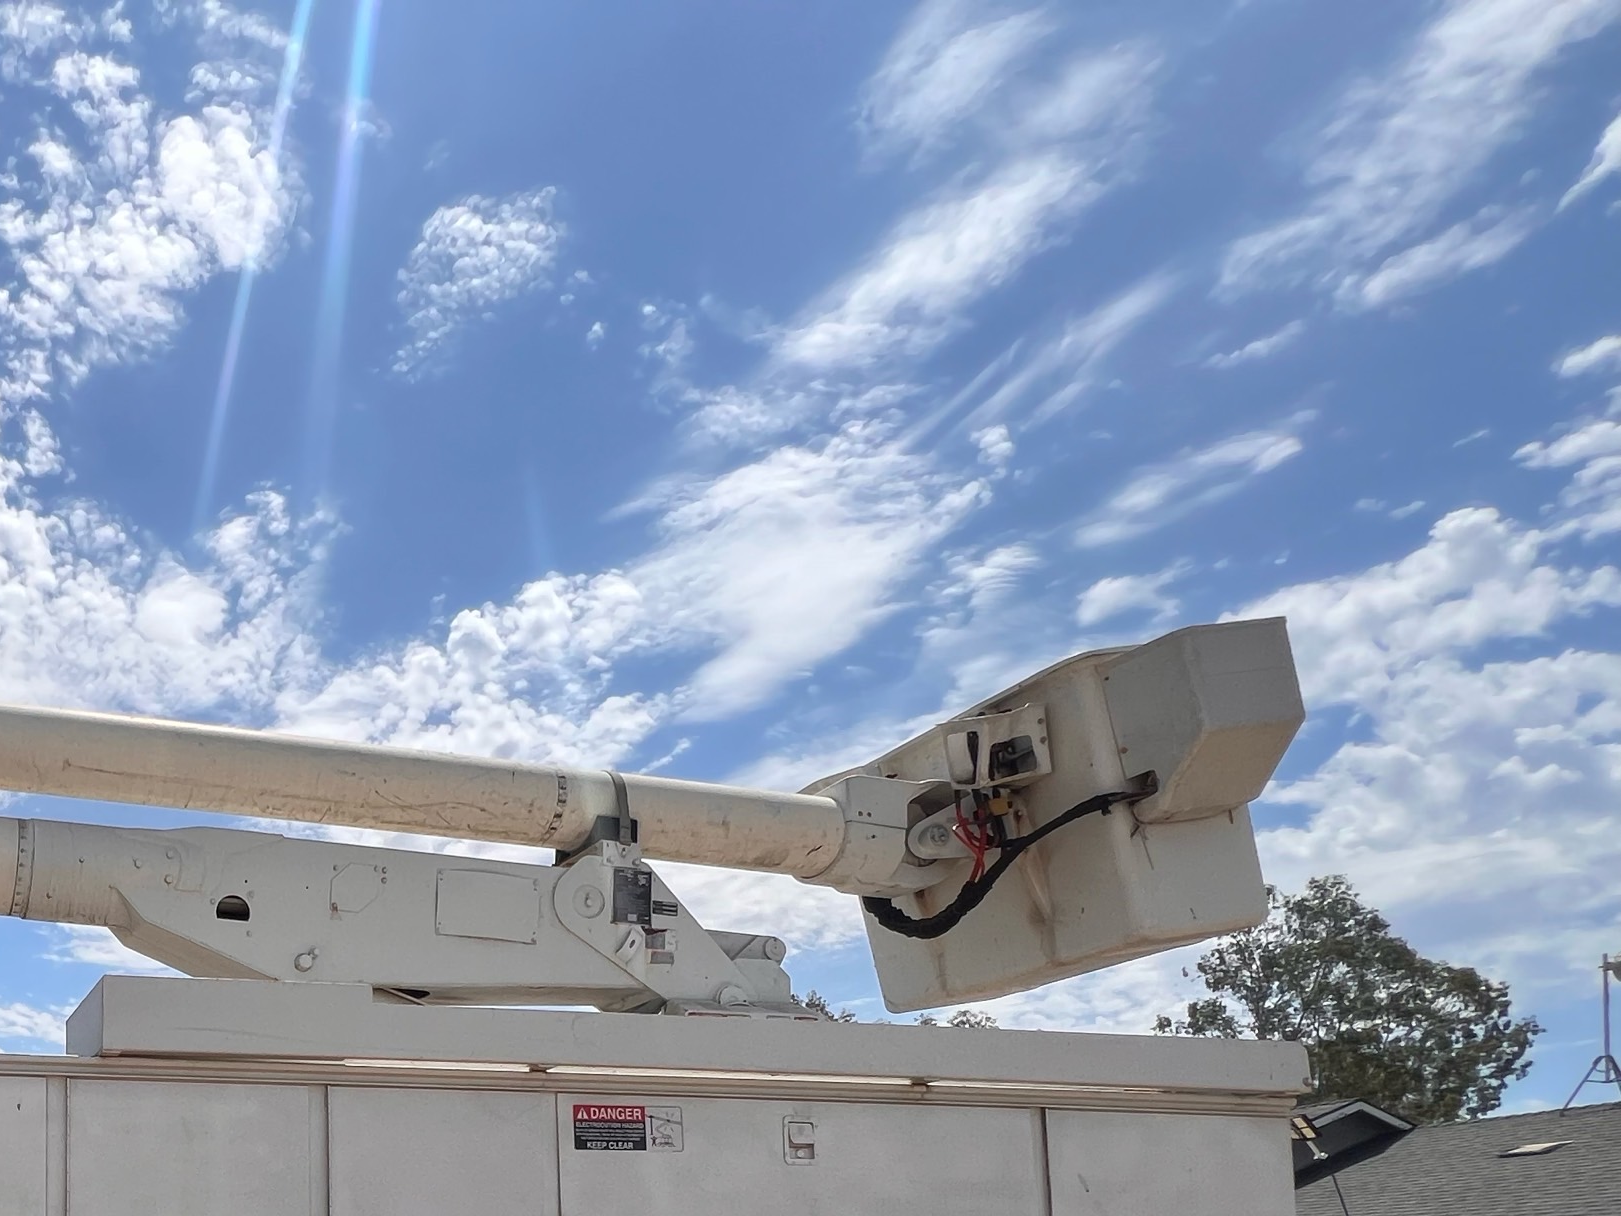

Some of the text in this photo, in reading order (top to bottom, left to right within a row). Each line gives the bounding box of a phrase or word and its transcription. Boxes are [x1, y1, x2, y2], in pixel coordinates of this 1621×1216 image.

[590, 1107, 642, 1120] DANGER
[586, 1141, 634, 1149] KEEP CLEAR
